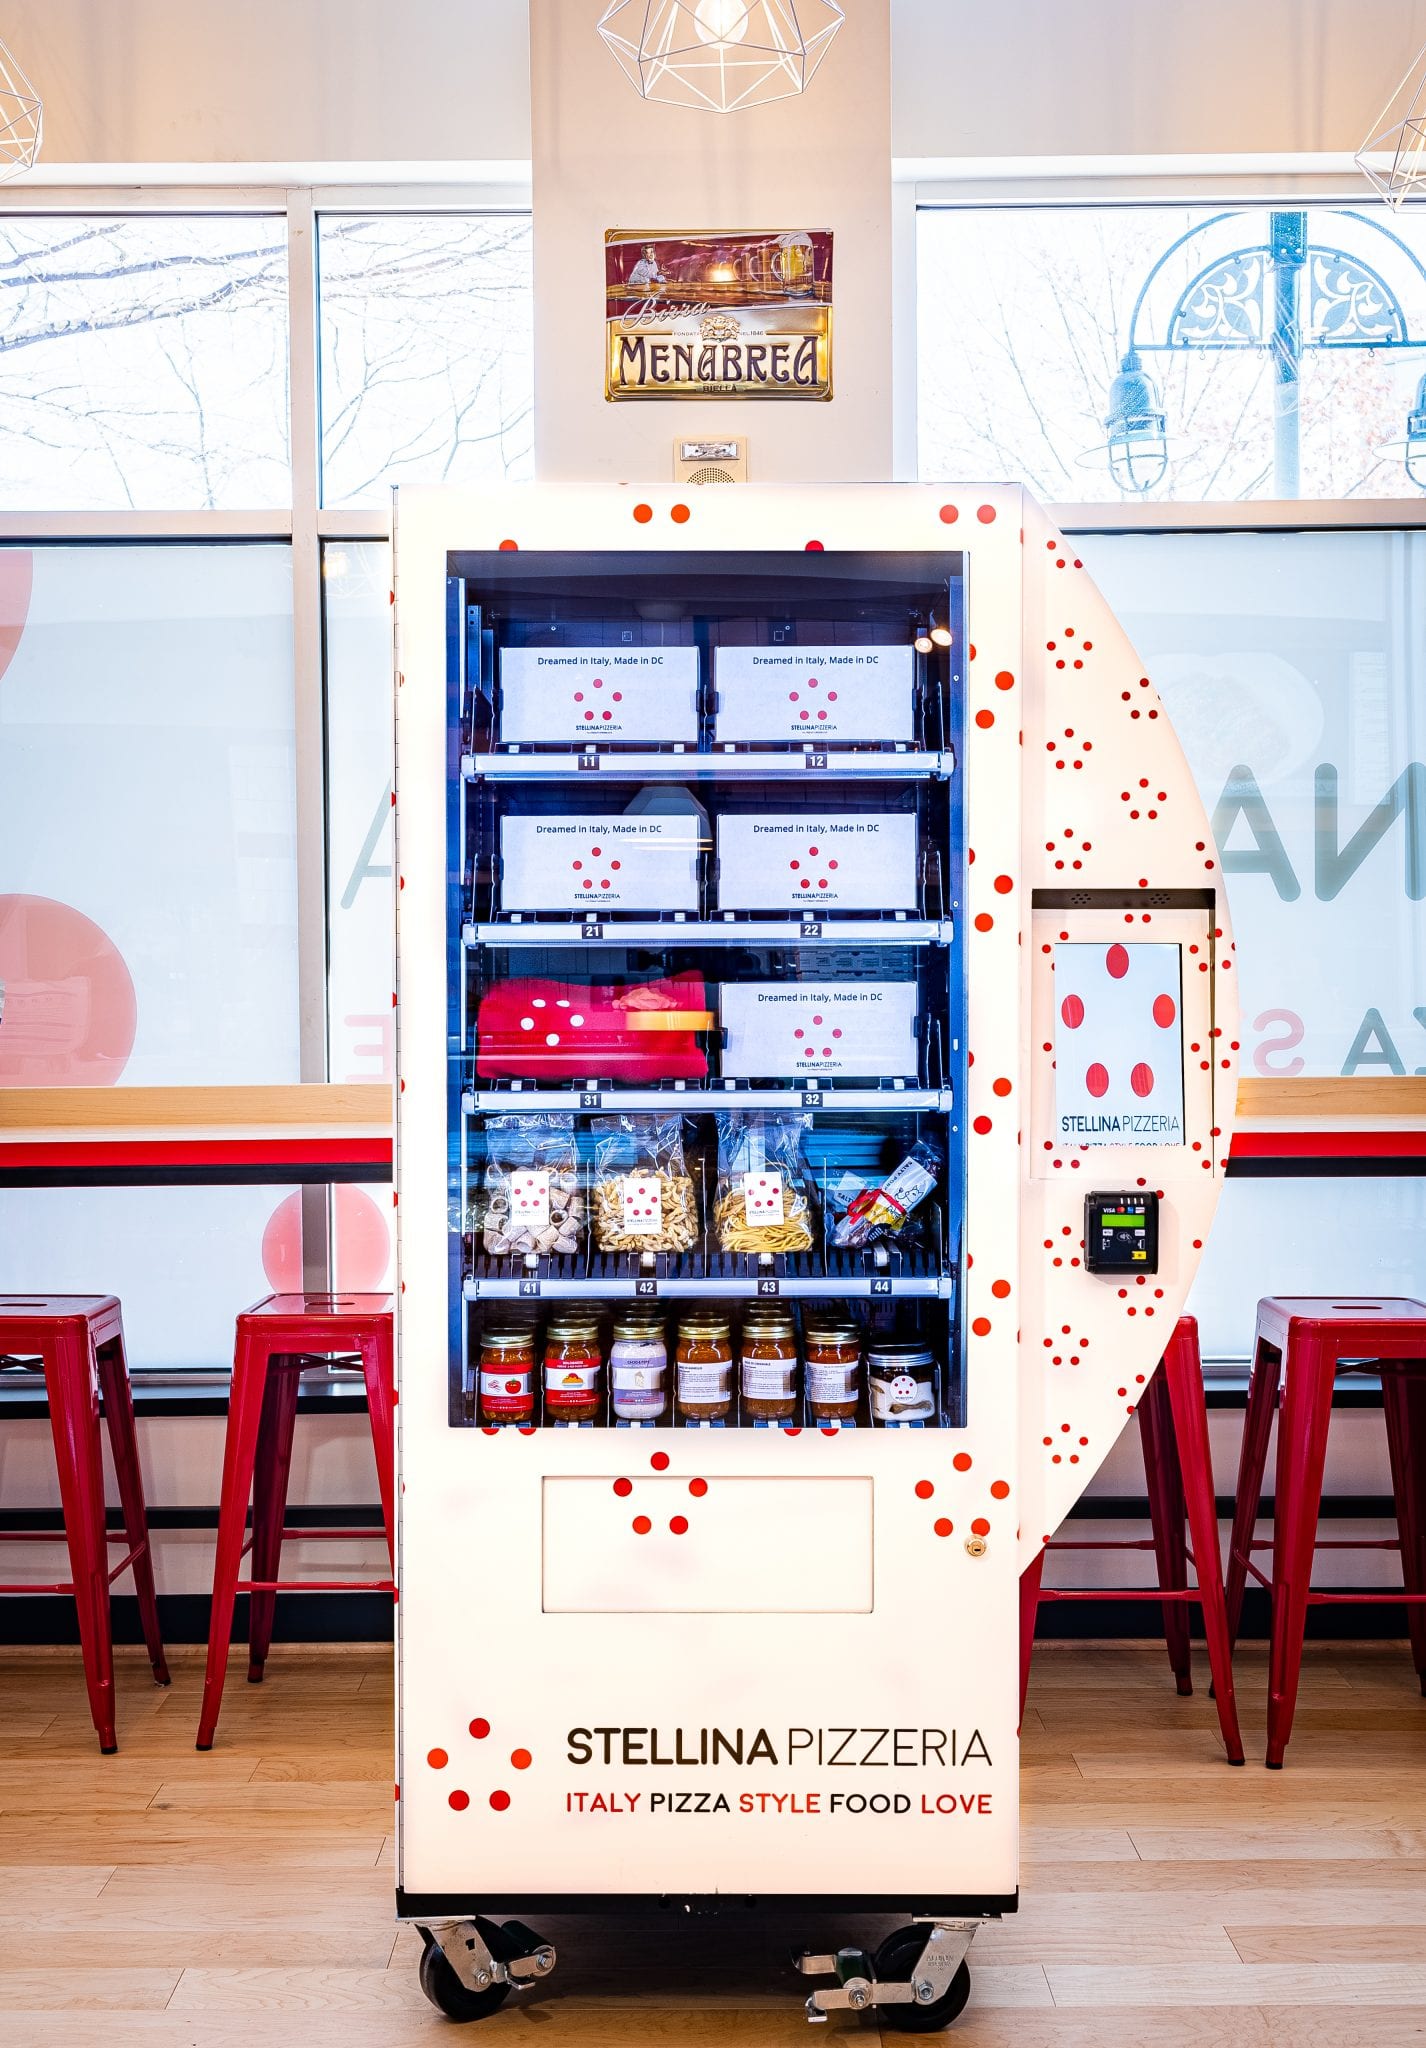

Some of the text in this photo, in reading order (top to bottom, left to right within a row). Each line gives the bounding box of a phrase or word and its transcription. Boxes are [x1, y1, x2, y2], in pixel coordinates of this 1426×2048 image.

[620, 290, 711, 329] Birra
[619, 336, 820, 386] MENABREA
[538, 656, 664, 666] Dreamed in Italy, Made in DC
[753, 656, 879, 666] Dreamed in Italy, Made in DC
[582, 756, 595, 767] 11
[809, 756, 824, 767] 12
[536, 825, 662, 835] Dreamed in Italy, Made in DC
[753, 824, 880, 834] Dreamed in Italy, Made in DC
[586, 926, 599, 937] 21
[804, 925, 818, 936] 22
[758, 993, 883, 1003] Dreamed in Italy, Made in DC
[584, 1094, 598, 1106] 31
[805, 1094, 820, 1105] 32
[523, 1282, 537, 1293] 41
[639, 1282, 654, 1293] 42
[761, 1281, 776, 1293] 43
[874, 1281, 889, 1292] 44
[567, 1728, 993, 1767] STELLINA PIZZERIA
[566, 1793, 993, 1814] ITALY PIZZA STYLE FOOD LOVE
